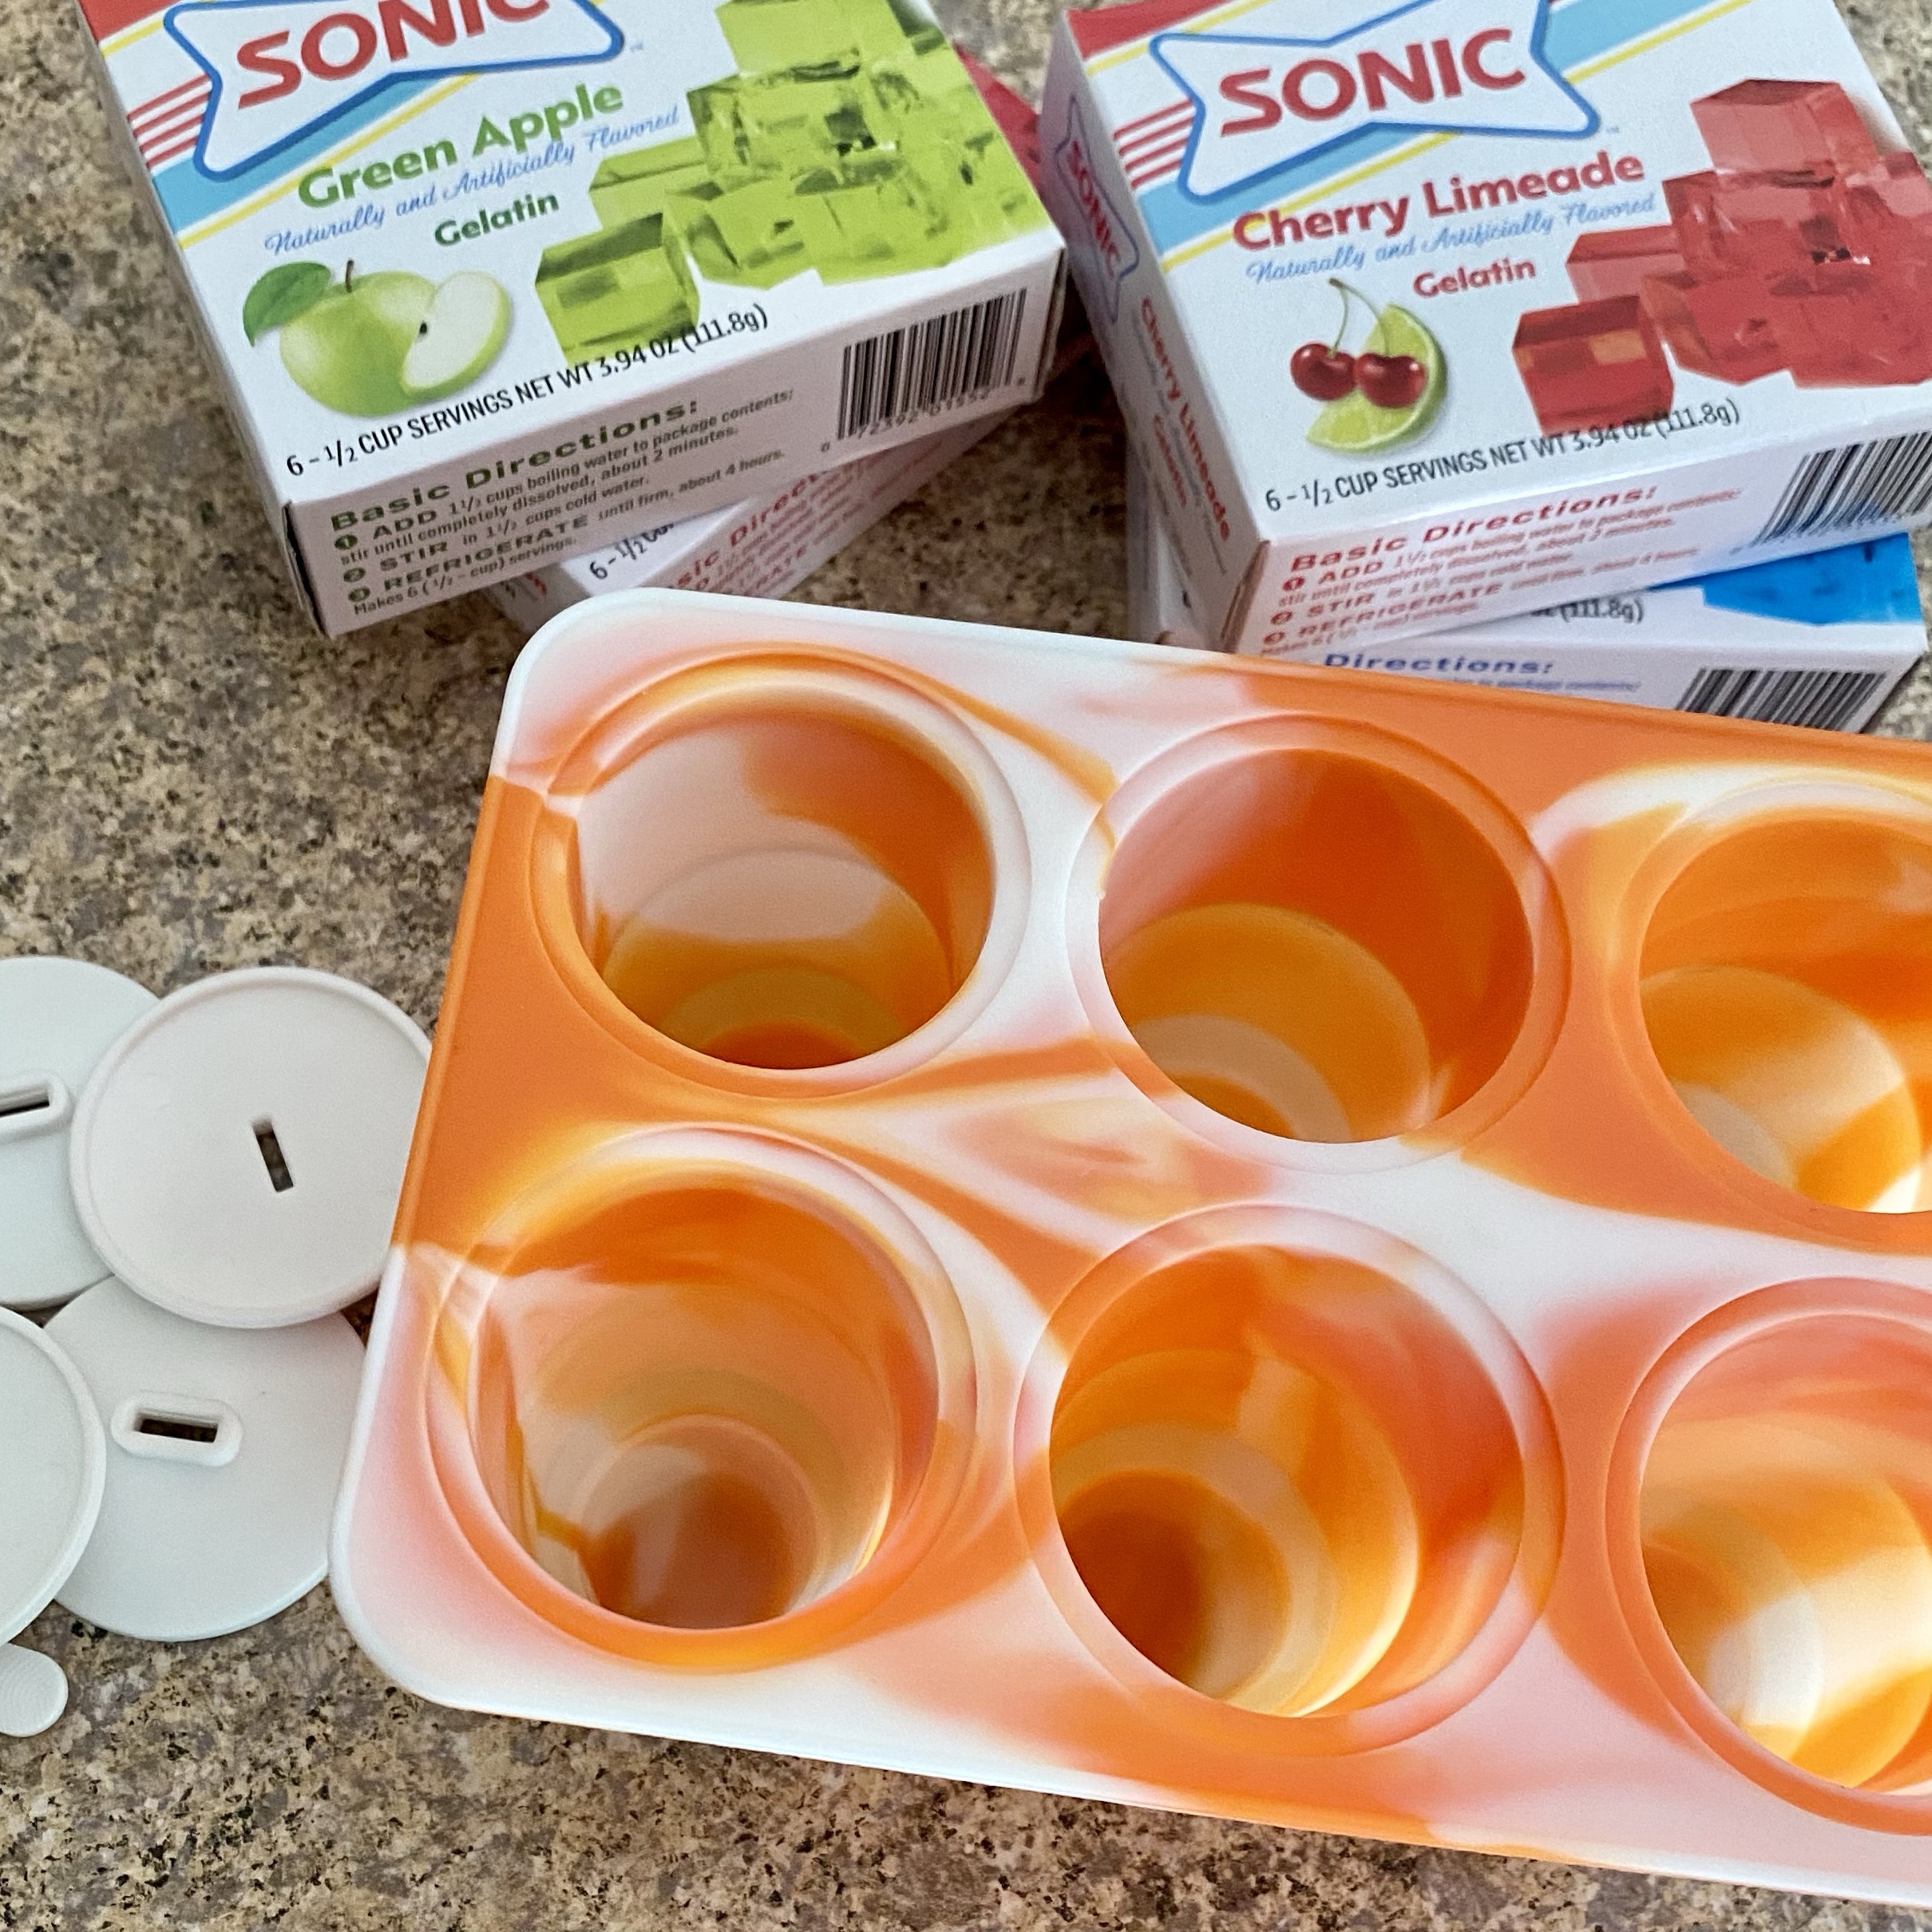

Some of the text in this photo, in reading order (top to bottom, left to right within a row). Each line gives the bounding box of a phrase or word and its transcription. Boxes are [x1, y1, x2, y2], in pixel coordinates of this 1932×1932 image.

[1220, 28, 1526, 137] SONIC
[264, 105, 679, 254] Naturally and Artificially Flavored
[298, 83, 624, 208] Green Apple
[434, 193, 559, 247] Gelatin
[1067, 141, 1122, 278] SONIC
[1232, 150, 1645, 251] Cherry Limeade
[1245, 193, 1656, 284] Naturally and Artificially Flavored
[1413, 254, 1537, 298] Gelatin
[286, 455, 303, 476] 6
[358, 424, 402, 454] CUP
[407, 390, 513, 440] SERVINGS
[515, 375, 555, 405] NET
[556, 362, 594, 390] WT
[598, 343, 647, 378] 3.94
[682, 303, 768, 353] (111.8g)
[1141, 295, 1182, 401] Cherry
[1179, 402, 1230, 540] Limeade
[331, 401, 698, 531] Basic Directions:
[374, 509, 437, 540] ADD
[486, 481, 523, 505] cups
[528, 462, 580, 489] boiling
[584, 446, 628, 469] water
[633, 438, 648, 452] to
[653, 414, 718, 449] package
[1265, 489, 1281, 512] 6
[1334, 471, 1378, 499] CUP
[1381, 449, 1488, 489] SERVINGS
[1489, 438, 1530, 468] NET
[1533, 431, 1570, 458] WT
[1571, 422, 1622, 451] 3.94
[1653, 398, 1740, 439] (111.8g)
[340, 548, 369, 565] stir
[374, 532, 413, 556] until
[418, 502, 508, 541] completely
[513, 475, 596, 511] dissolved,
[601, 455, 647, 481] about
[654, 448, 663, 462] 2
[379, 541, 448, 572] STIR
[463, 533, 477, 546] in
[525, 505, 561, 526] cups
[565, 490, 597, 512] cold
[602, 476, 649, 498] water.
[384, 515, 588, 592] REFRIGERATE
[599, 499, 633, 521] until
[679, 469, 721, 493] about
[725, 463, 737, 476] 4
[1291, 485, 1658, 572] Basic Directions:
[354, 593, 404, 616] Makes
[509, 535, 577, 564] servings.
[589, 561, 608, 581] 6
[1298, 581, 1503, 638] REFRIGERATE
[1308, 592, 1375, 617] STIR
[1318, 560, 1384, 585] ADD
[1561, 597, 1645, 625] (111.8g)
[1324, 651, 1554, 675] Directions:
